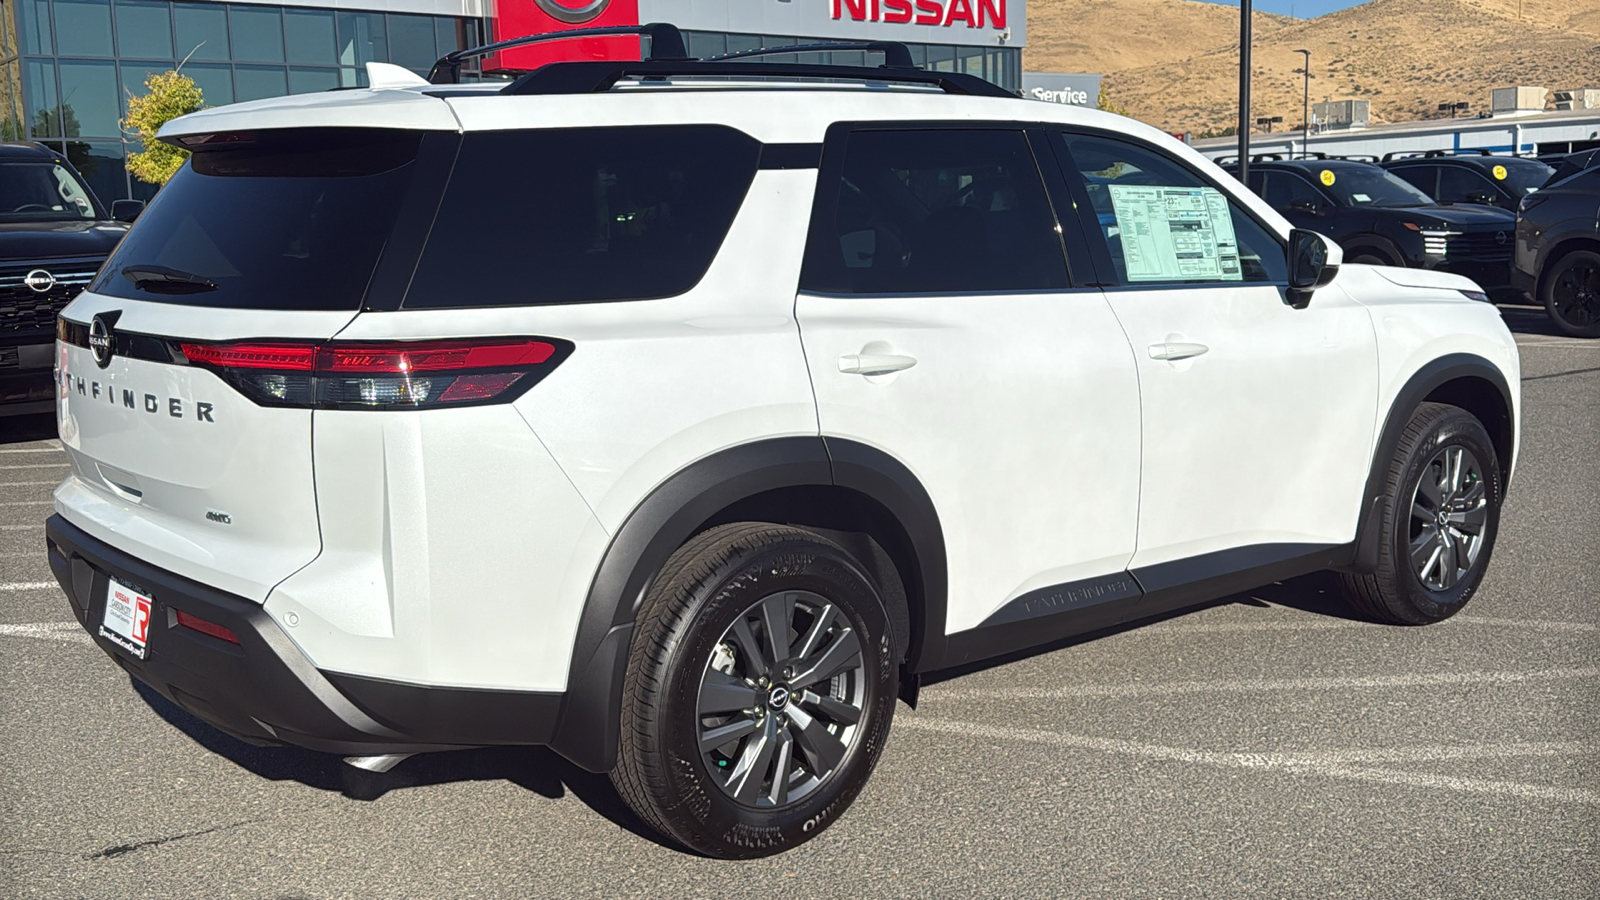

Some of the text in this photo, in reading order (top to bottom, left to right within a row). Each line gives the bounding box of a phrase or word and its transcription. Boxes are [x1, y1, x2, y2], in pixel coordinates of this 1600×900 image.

[831, 0, 1006, 28] NISSAN
[1031, 86, 1087, 104] Service
[54, 364, 214, 423] THFINDER
